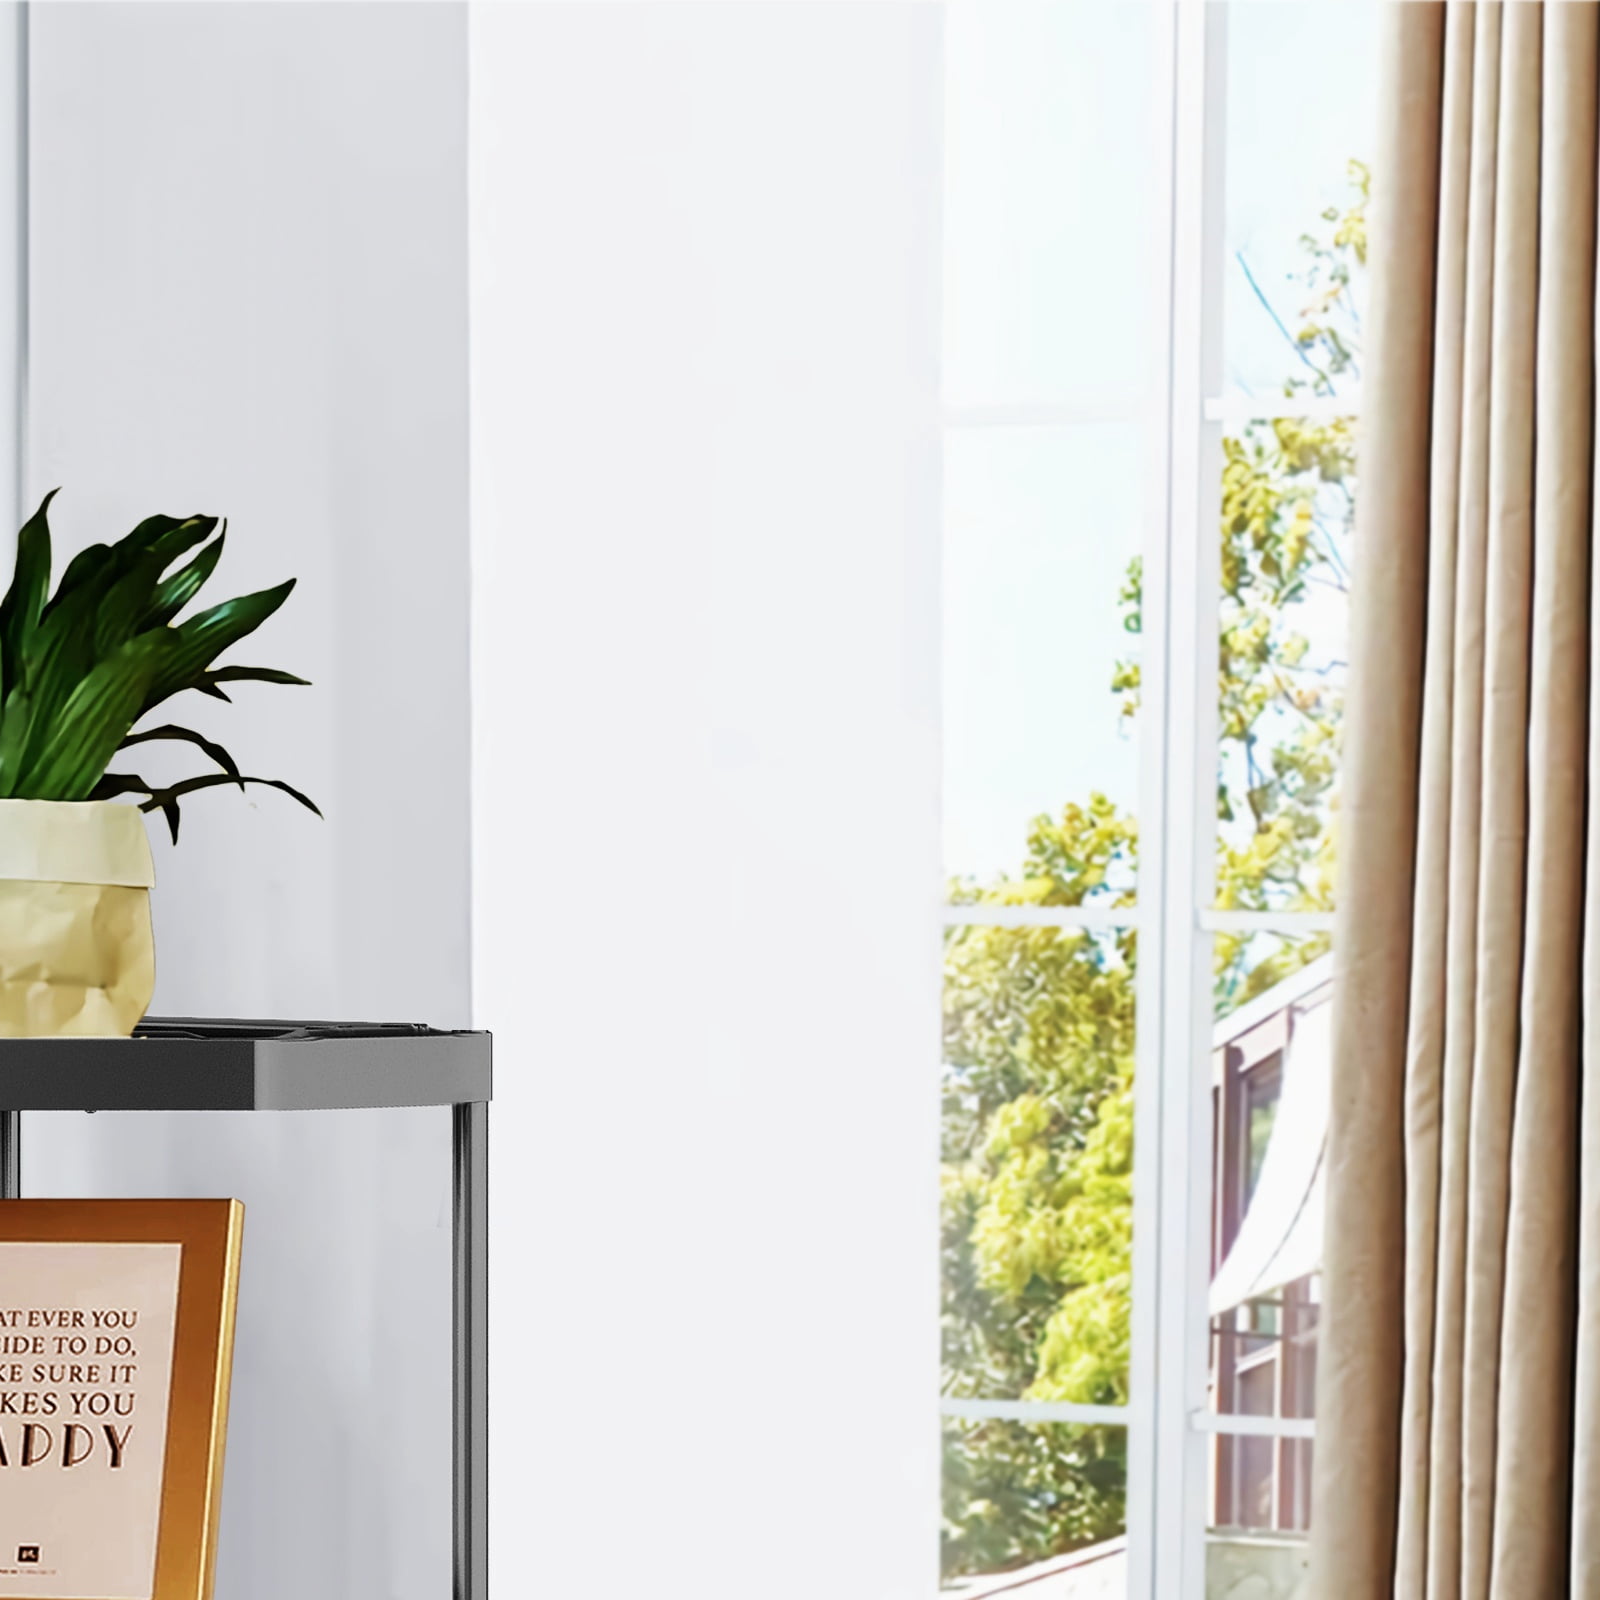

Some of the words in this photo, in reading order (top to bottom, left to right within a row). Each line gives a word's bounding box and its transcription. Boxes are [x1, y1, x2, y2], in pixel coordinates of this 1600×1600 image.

[28, 1310, 85, 1328] EVER
[92, 1310, 137, 1328] YOU
[53, 1336, 87, 1355] TO
[95, 1336, 136, 1357] DO,
[32, 1364, 100, 1383] SURE
[110, 1365, 137, 1383] IT
[70, 1392, 135, 1416] YOU
